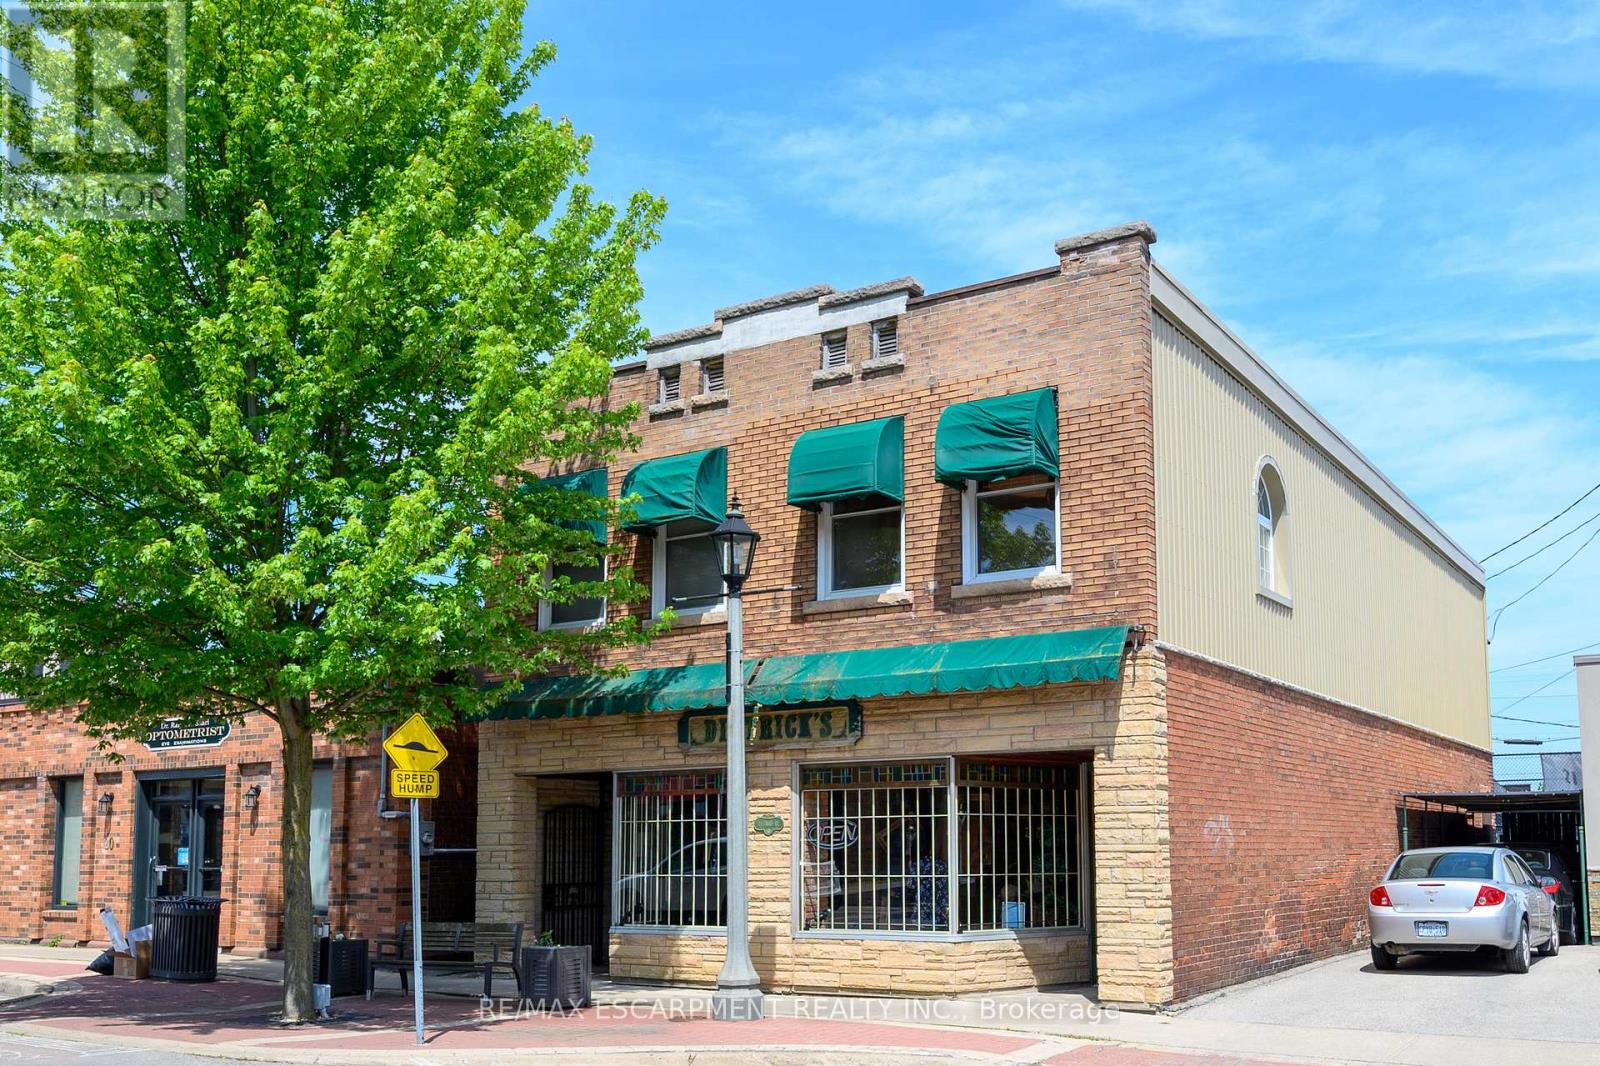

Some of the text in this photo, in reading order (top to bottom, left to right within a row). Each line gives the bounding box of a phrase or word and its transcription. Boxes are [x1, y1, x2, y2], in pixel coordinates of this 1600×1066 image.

[146, 725, 225, 742] OPTOMETRIST
[173, 738, 207, 746] EXAMINATIONS
[396, 773, 435, 784] SPEED
[399, 783, 433, 793] HUMP
[809, 825, 857, 842] OPEN
